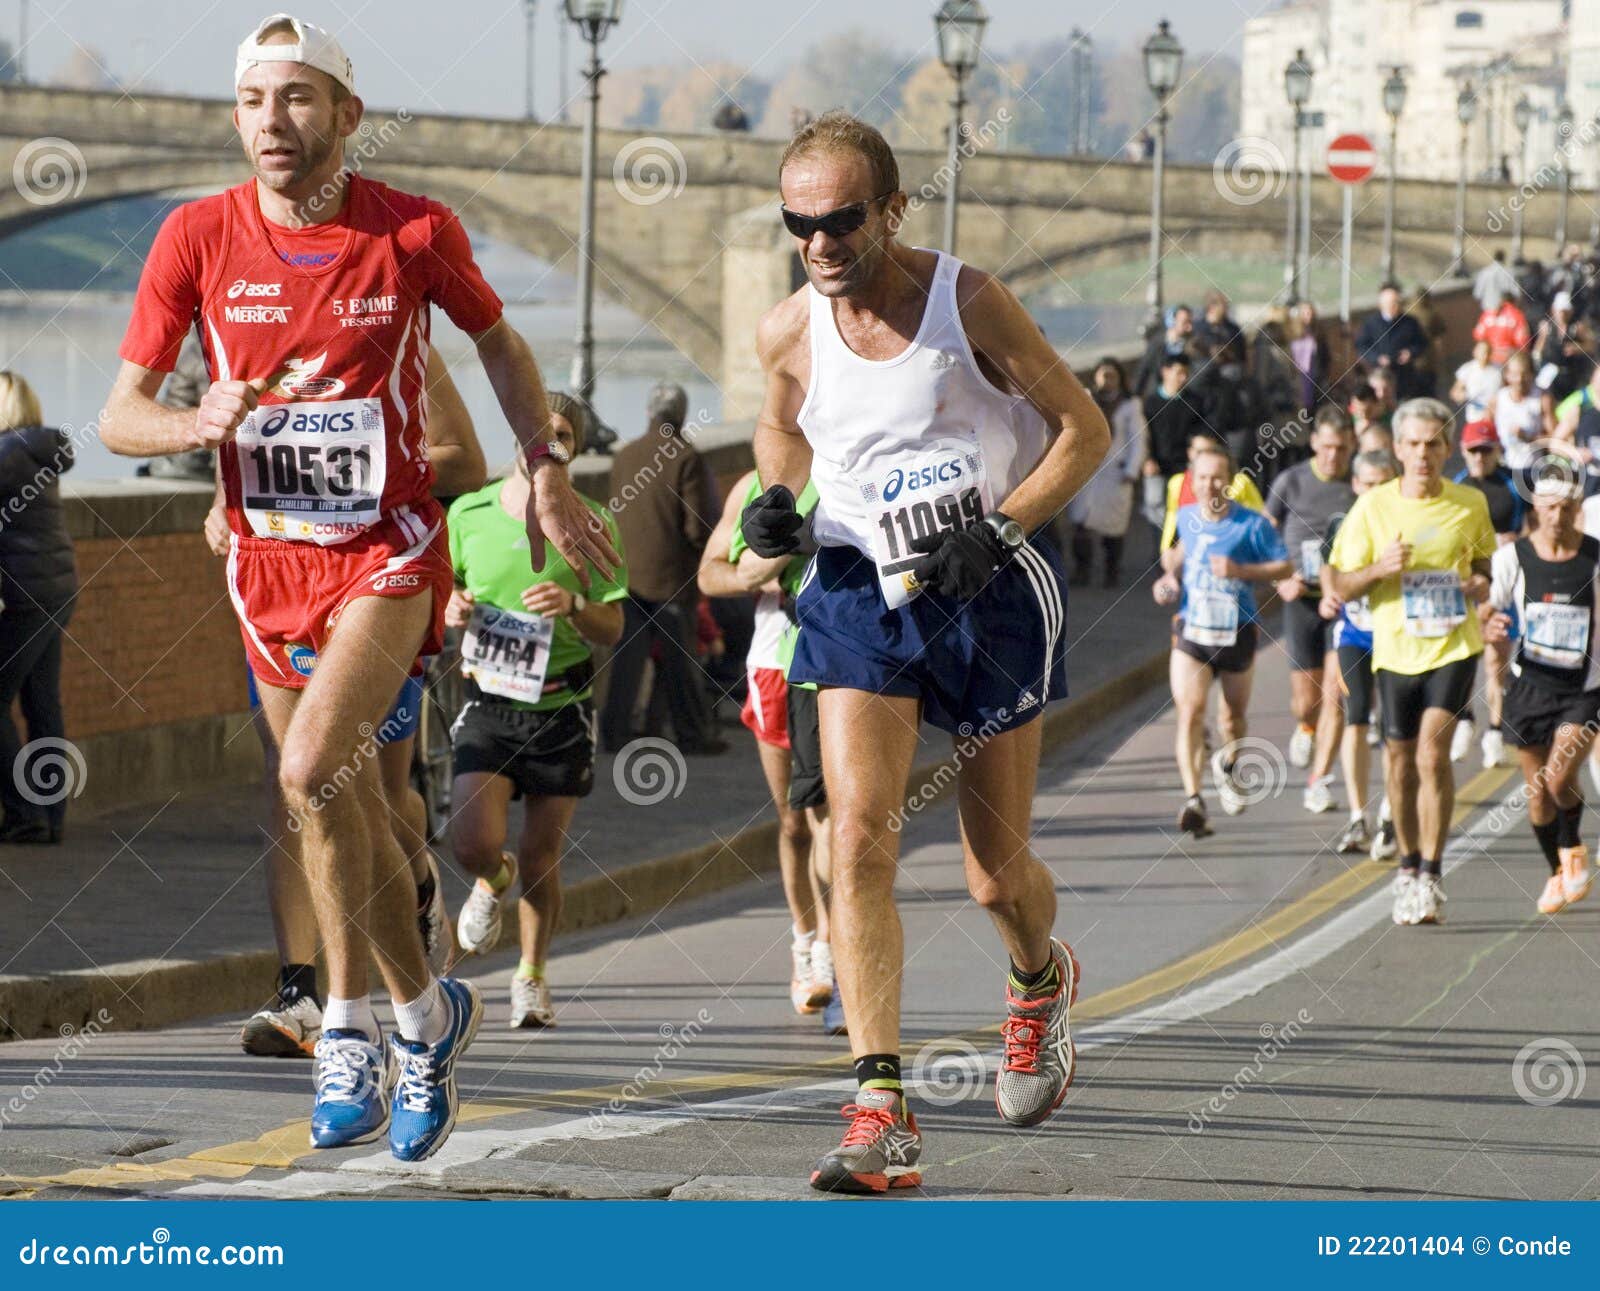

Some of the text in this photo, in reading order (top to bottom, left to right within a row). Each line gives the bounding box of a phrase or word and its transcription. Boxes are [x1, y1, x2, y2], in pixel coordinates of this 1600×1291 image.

[245, 283, 282, 297] asics
[224, 305, 293, 323] MERICAT
[332, 295, 399, 316] 5 EMME
[339, 315, 393, 328] TESSUTI
[291, 411, 355, 433] asics
[250, 444, 371, 497] 10531
[907, 458, 962, 491] asics
[878, 486, 985, 560] 11099
[388, 574, 420, 587] asics
[474, 627, 538, 671] 9764
